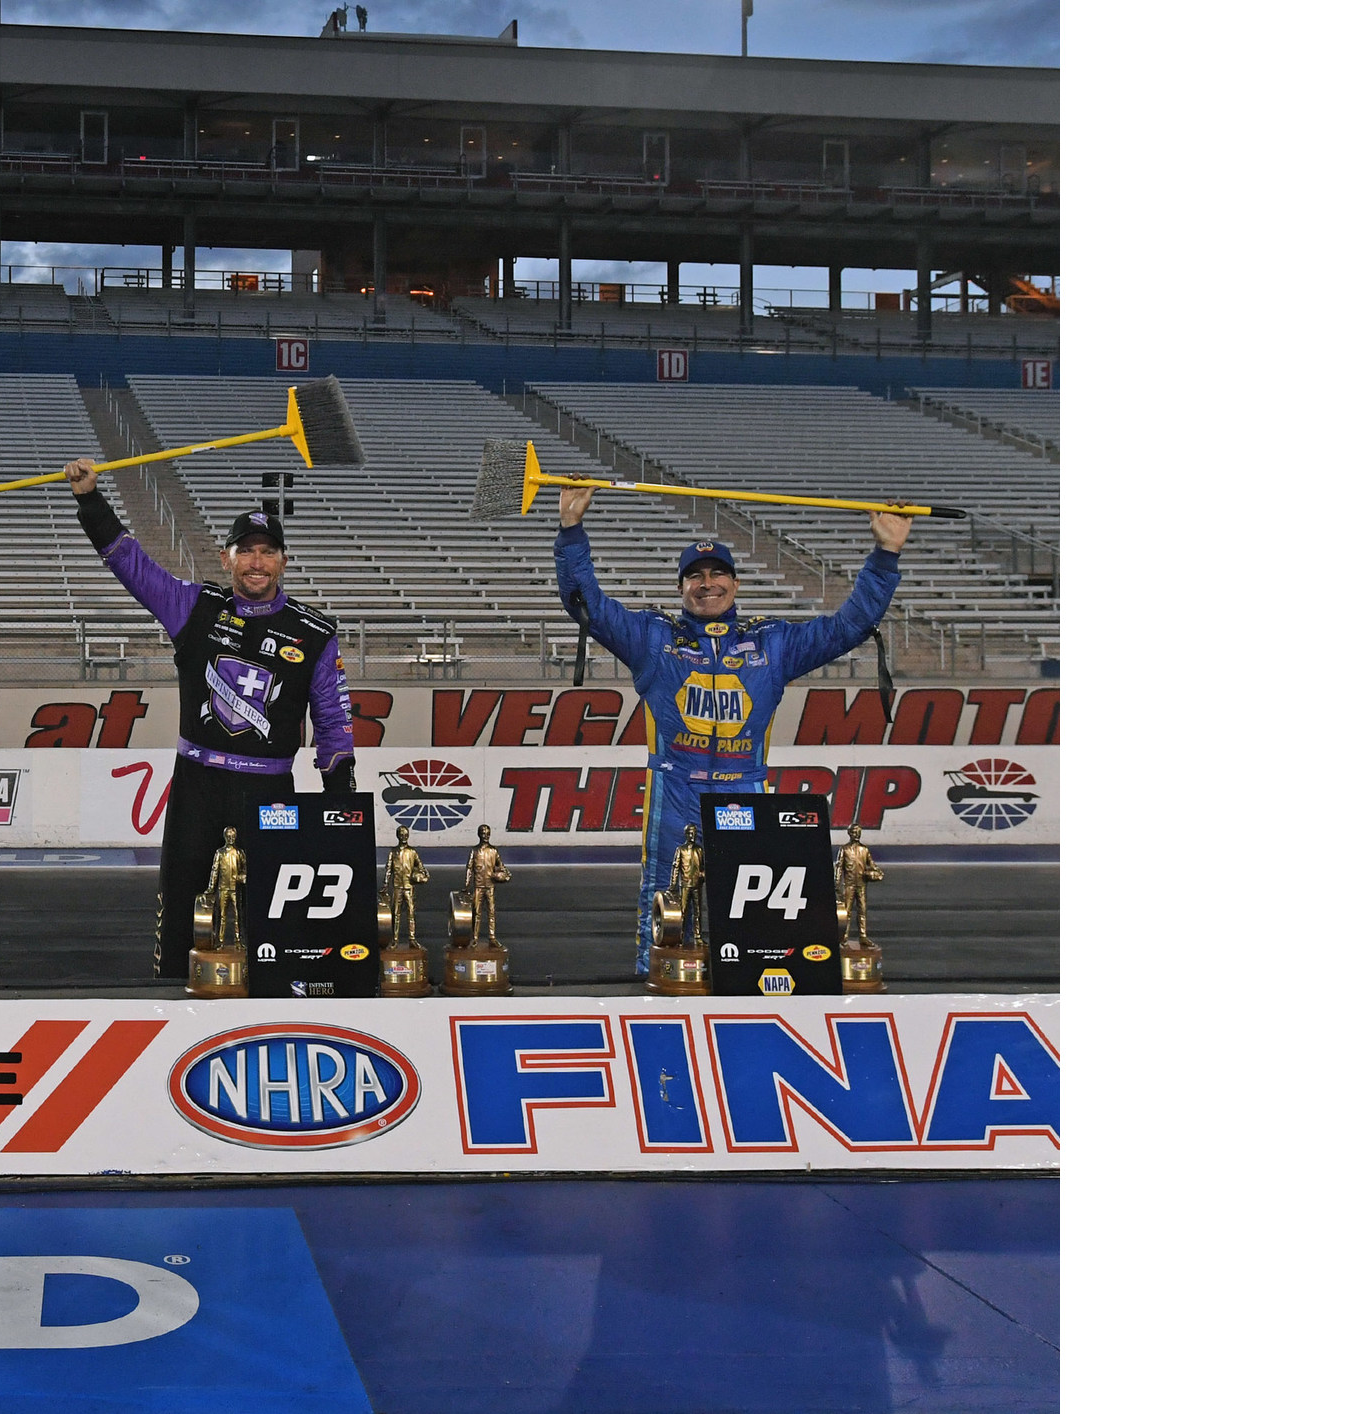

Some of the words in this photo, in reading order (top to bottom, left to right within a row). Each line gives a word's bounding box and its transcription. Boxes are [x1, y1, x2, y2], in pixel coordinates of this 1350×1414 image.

[280, 342, 305, 368] 1C
[661, 352, 685, 378] 1D
[1025, 362, 1048, 387] 1E
[207, 668, 241, 710] INFINITE
[244, 704, 269, 730] HERO
[686, 687, 742, 721] NAPA
[25, 691, 149, 749] at
[672, 732, 710, 748] AUTO
[716, 738, 753, 752] PARTS
[712, 771, 743, 782] Capps
[500, 767, 647, 833] THE
[260, 817, 296, 825] WORLD
[717, 817, 752, 826] WORLD
[268, 864, 353, 919] P3
[729, 864, 807, 920] P4
[806, 949, 827, 957] PENNZOIL
[309, 988, 335, 996] HERO
[764, 977, 791, 992] NAPA
[208, 1042, 388, 1125] NHRA
